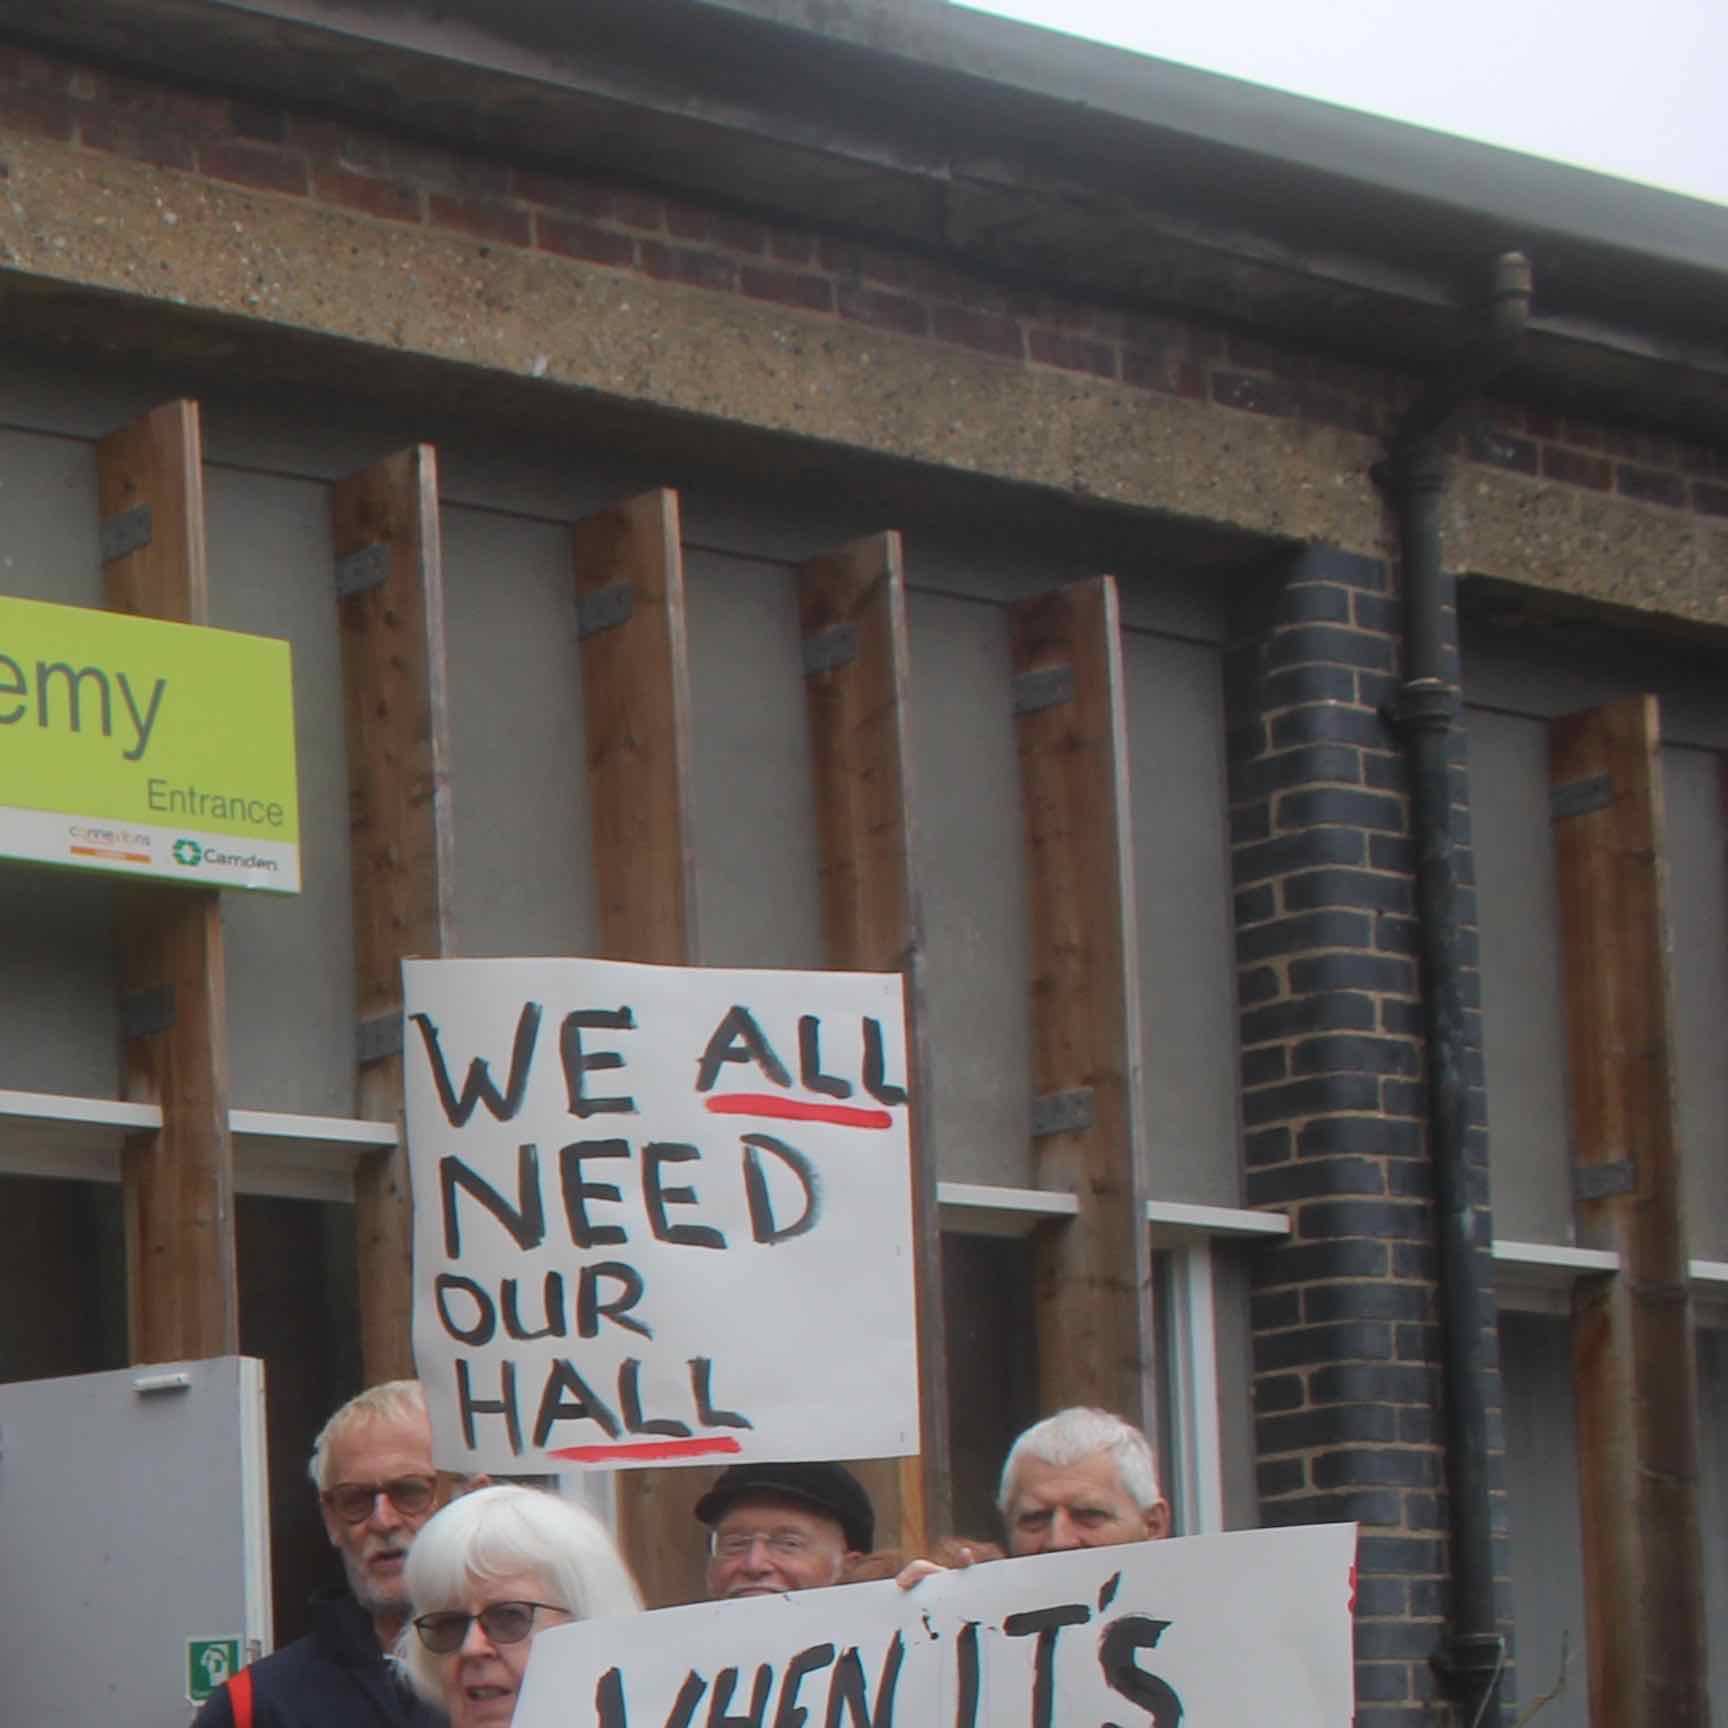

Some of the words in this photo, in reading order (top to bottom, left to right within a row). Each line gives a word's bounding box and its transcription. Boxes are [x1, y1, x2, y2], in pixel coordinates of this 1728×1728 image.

[147, 778, 284, 826] Entrance
[203, 848, 279, 872] Camden
[409, 1002, 640, 1128] WE
[696, 1005, 909, 1106] ALL
[439, 1133, 822, 1260] NEED
[435, 1261, 652, 1347] OUR
[455, 1357, 753, 1456] HALL
